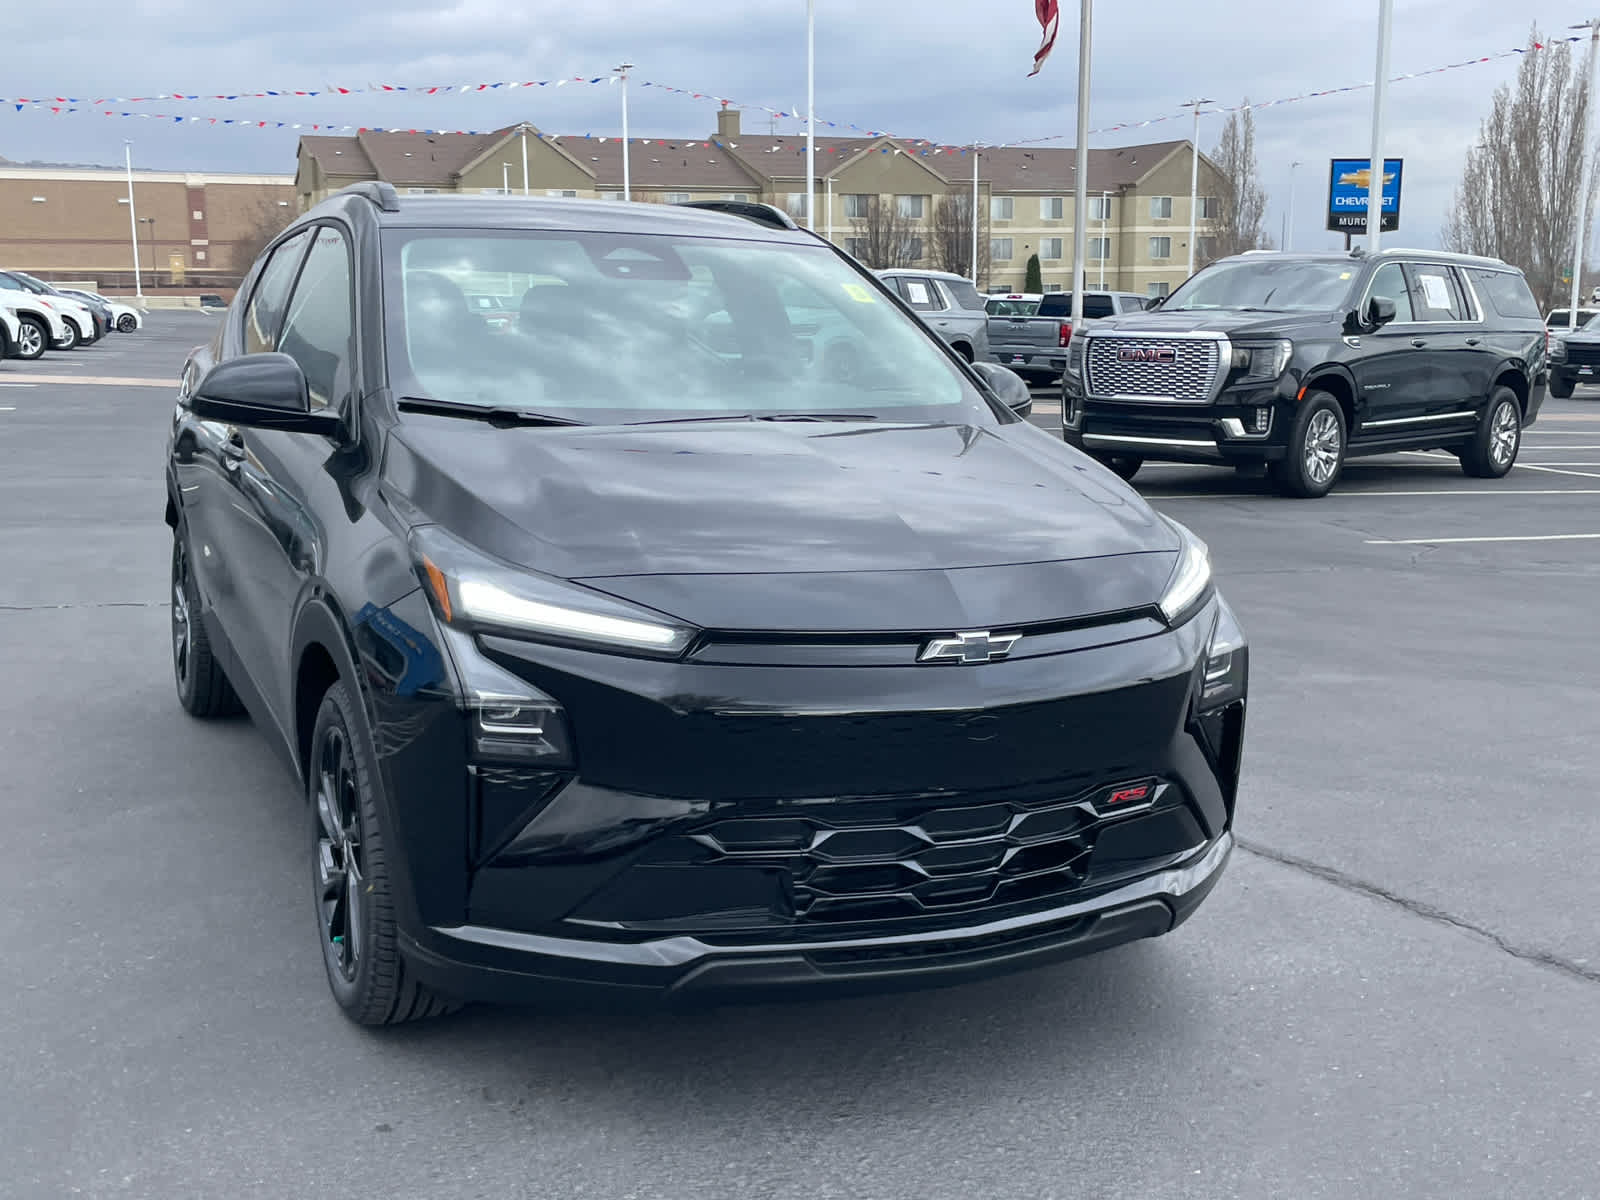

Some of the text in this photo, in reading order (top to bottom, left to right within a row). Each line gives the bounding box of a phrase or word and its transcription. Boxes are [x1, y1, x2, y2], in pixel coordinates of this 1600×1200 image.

[1335, 196, 1395, 206] CHEVRET
[1338, 217, 1387, 226] MURDK
[1119, 348, 1174, 363] GMC
[1108, 786, 1149, 803] RS
